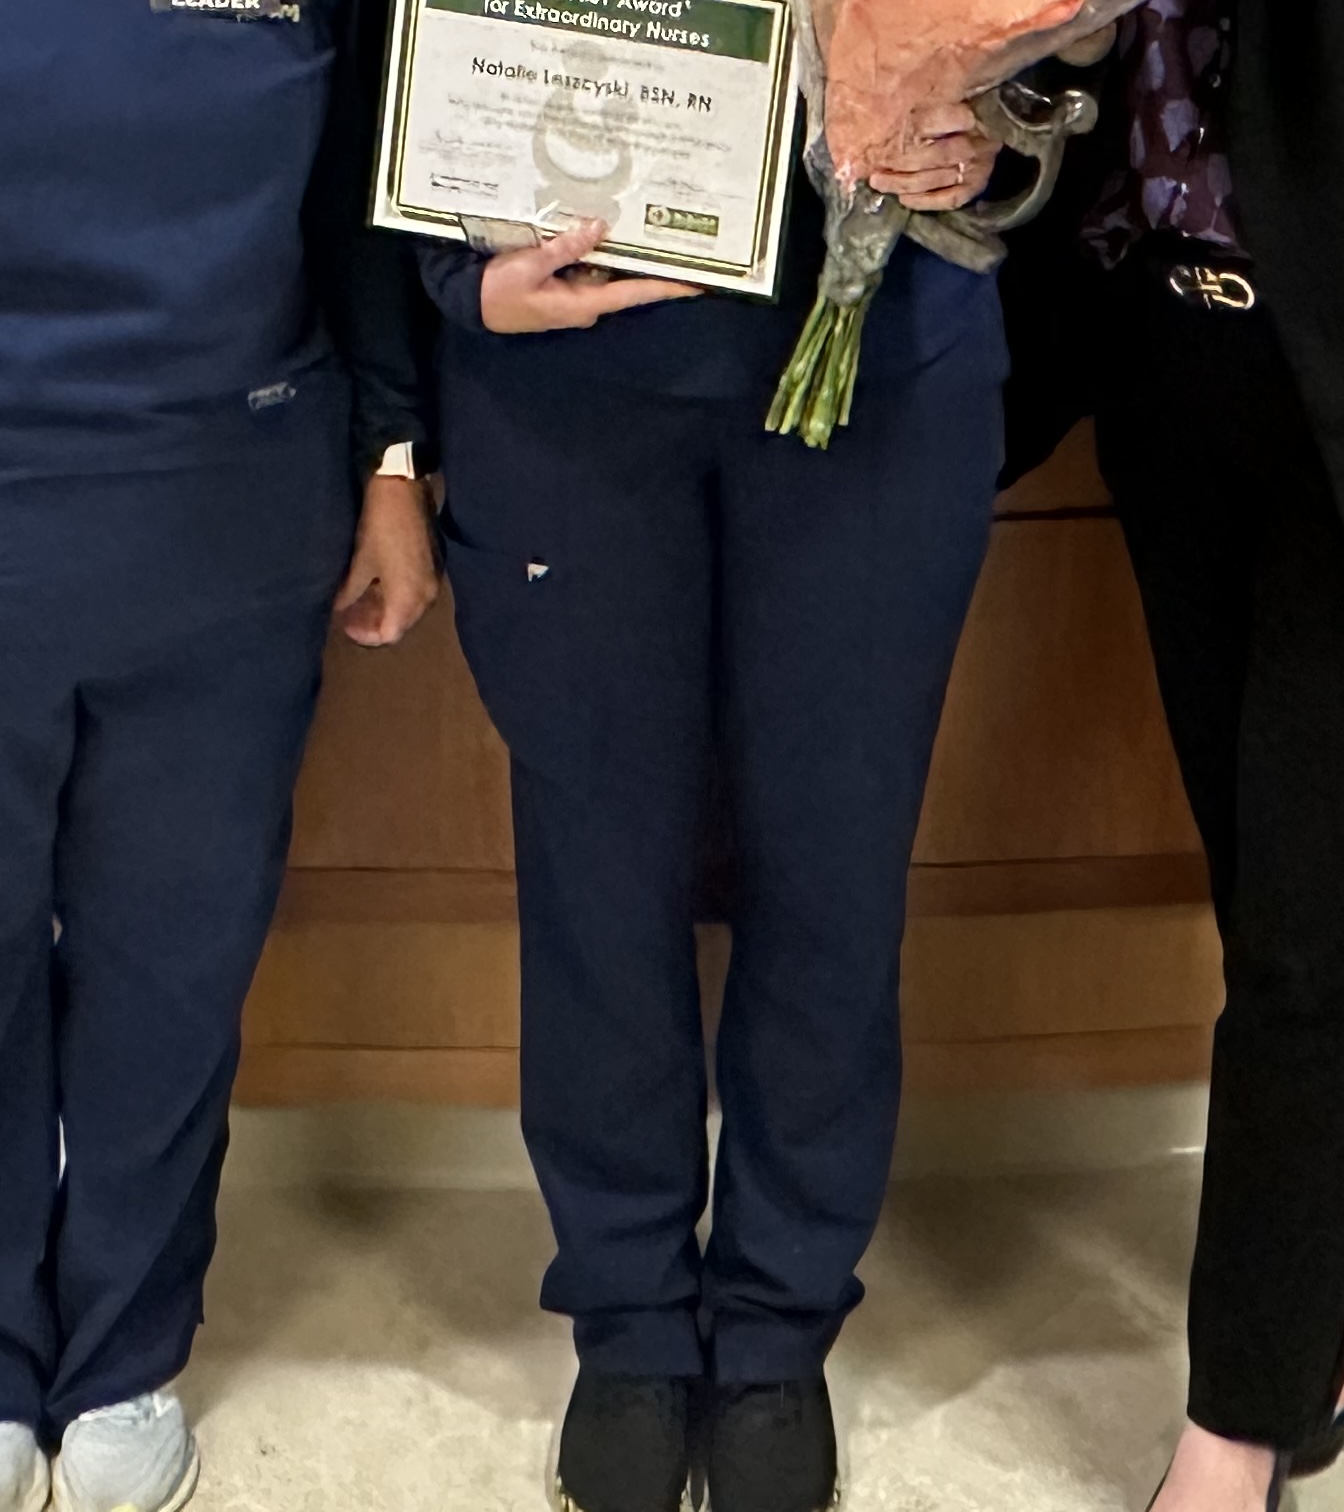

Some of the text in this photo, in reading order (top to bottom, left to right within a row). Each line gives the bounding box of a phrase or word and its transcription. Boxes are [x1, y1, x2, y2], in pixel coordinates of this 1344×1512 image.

[514, 0, 641, 38] Extraordinary
[647, 21, 710, 48] Nurses
[471, 55, 537, 81] Natalie
[687, 91, 712, 112] RN
